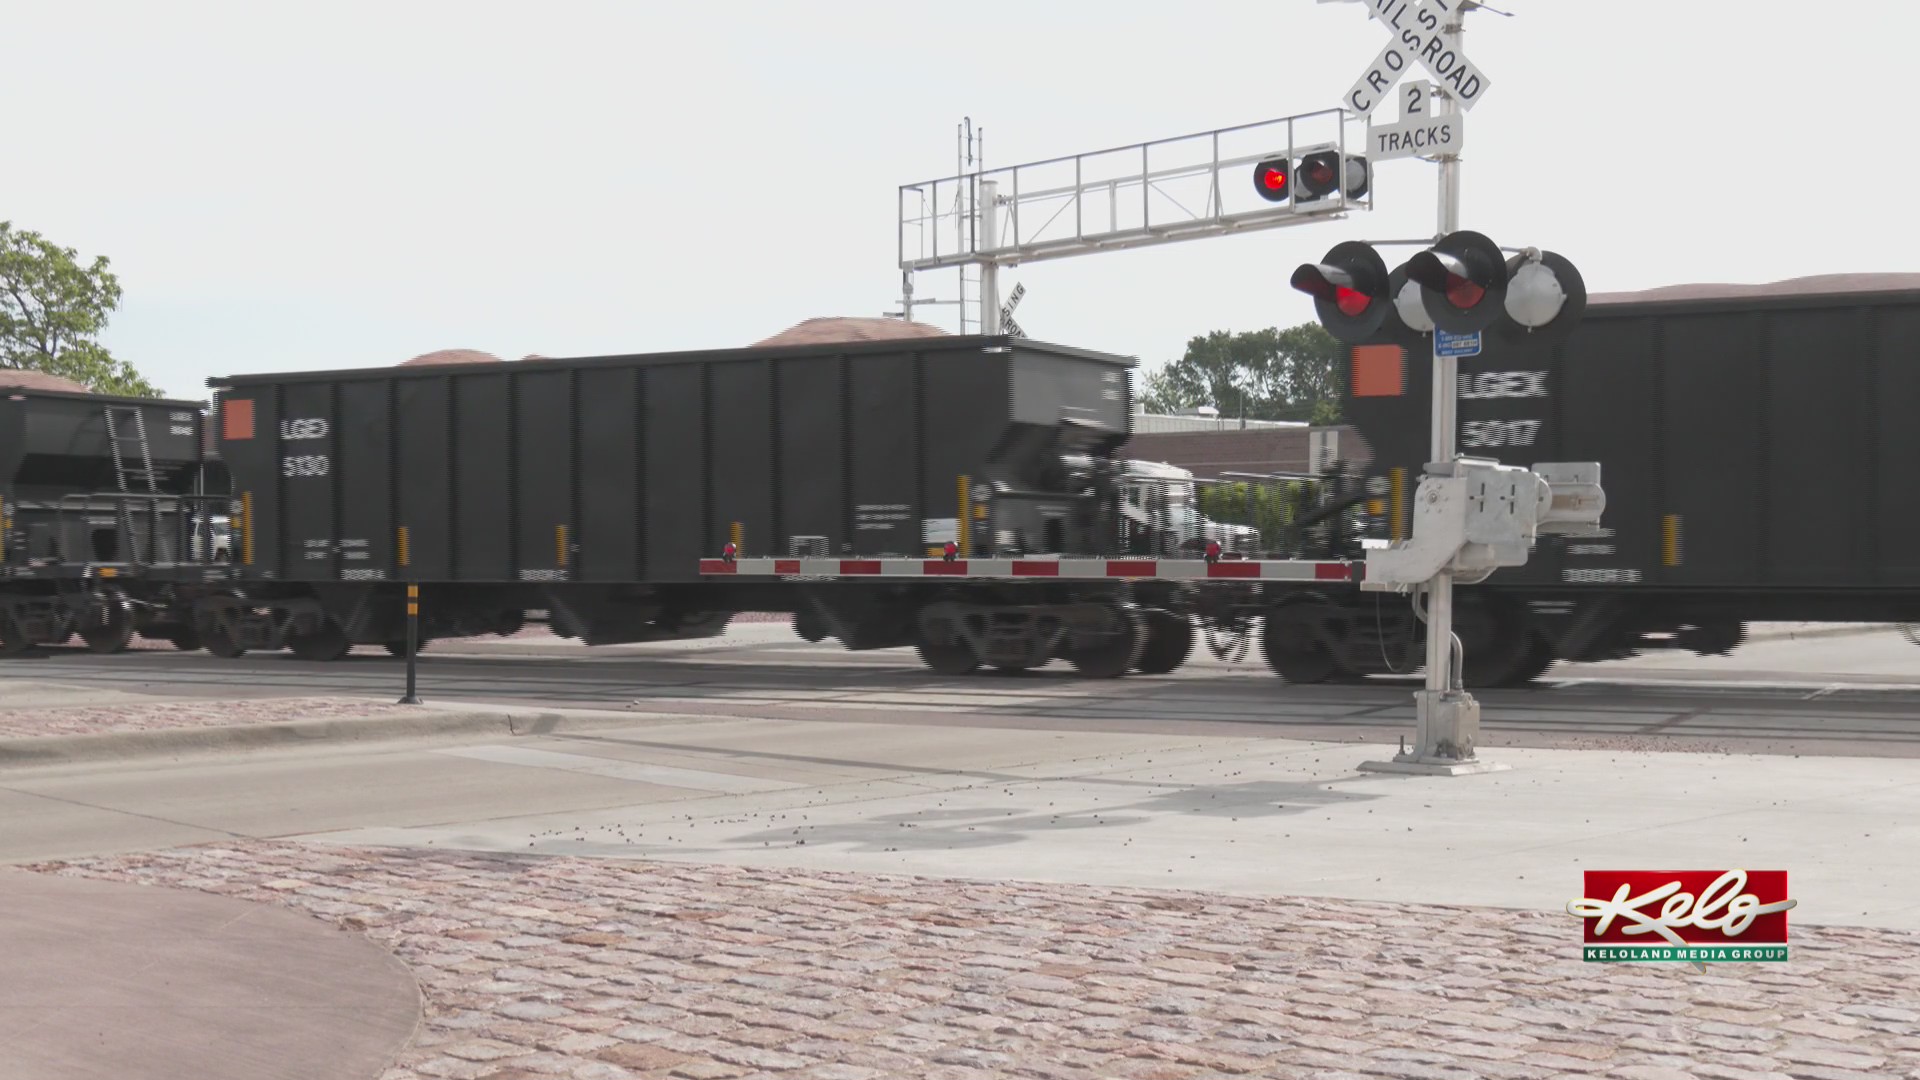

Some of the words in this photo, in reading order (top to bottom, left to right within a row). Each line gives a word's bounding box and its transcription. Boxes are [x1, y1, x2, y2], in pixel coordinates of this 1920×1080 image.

[1407, 88, 1422, 114] 2
[1378, 125, 1451, 152] TRACKS
[1458, 371, 1549, 399] LGEX
[1461, 420, 1542, 447] 5017
[282, 455, 330, 477] 5130
